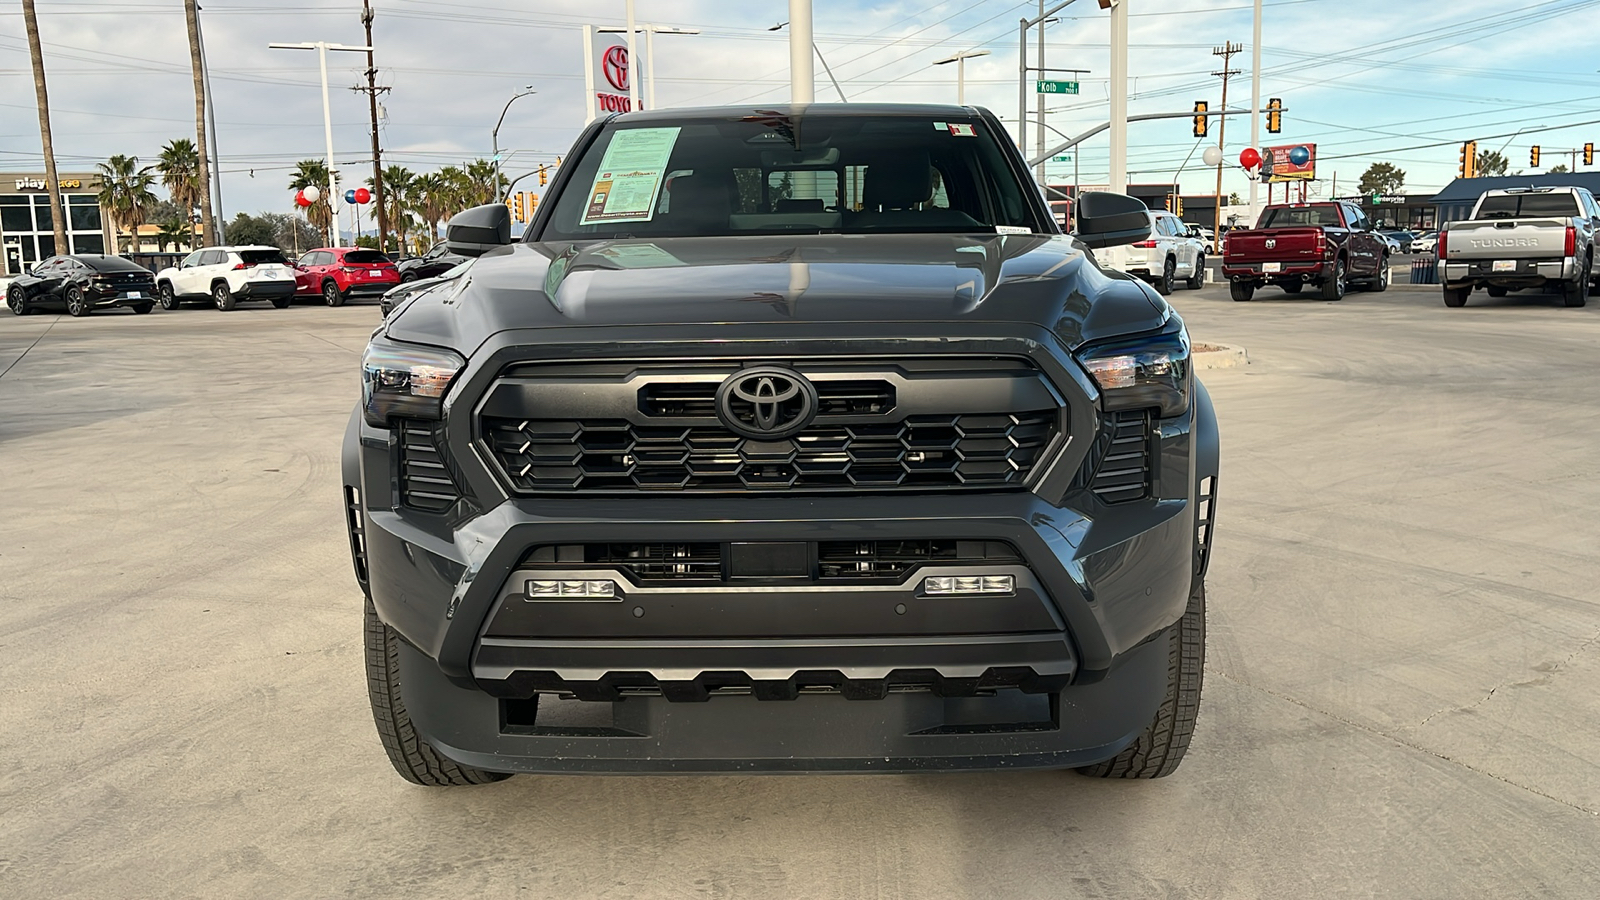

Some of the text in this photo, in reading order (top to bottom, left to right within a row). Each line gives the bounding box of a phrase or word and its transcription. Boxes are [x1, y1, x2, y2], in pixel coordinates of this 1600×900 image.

[1041, 82, 1057, 92] Kolb
[597, 93, 643, 113] TOYOA
[1470, 238, 1539, 248] TUNDRA
